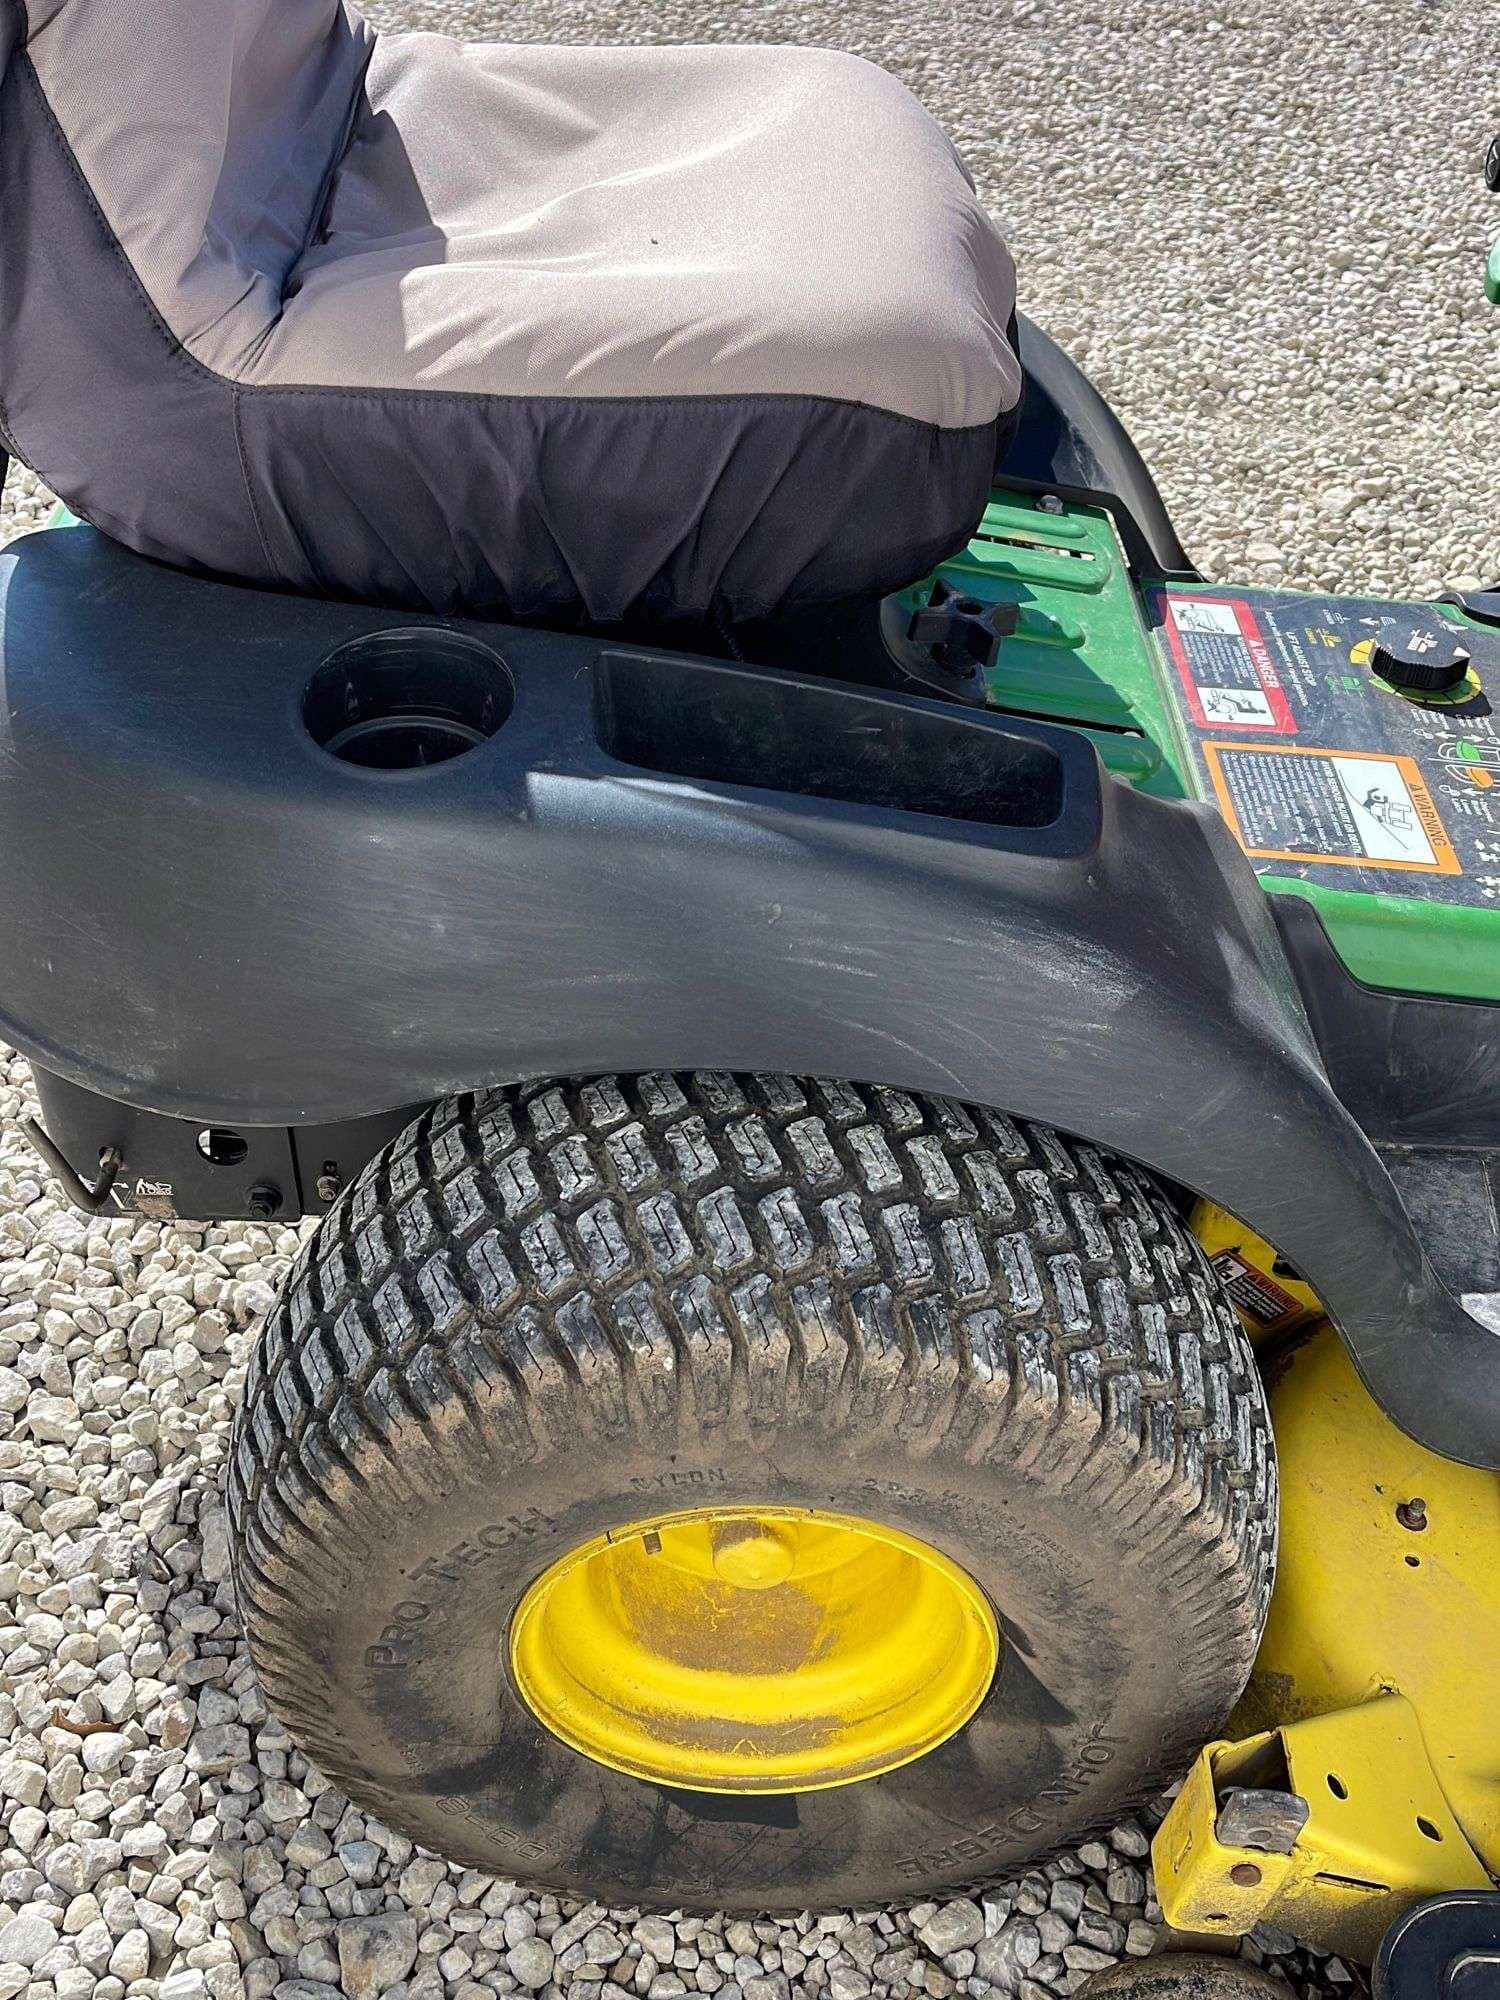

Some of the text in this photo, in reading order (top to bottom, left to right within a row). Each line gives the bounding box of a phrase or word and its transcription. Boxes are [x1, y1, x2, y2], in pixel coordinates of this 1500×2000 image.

[1252, 648, 1280, 688] DANGER
[1326, 777, 1343, 802] SERIOUS
[1347, 833, 1362, 853] DEATH
[1414, 790, 1447, 848] WARNING
[364, 1506, 556, 1668] PRO TECH
[894, 1722, 1130, 1878] JOHN DEERE
